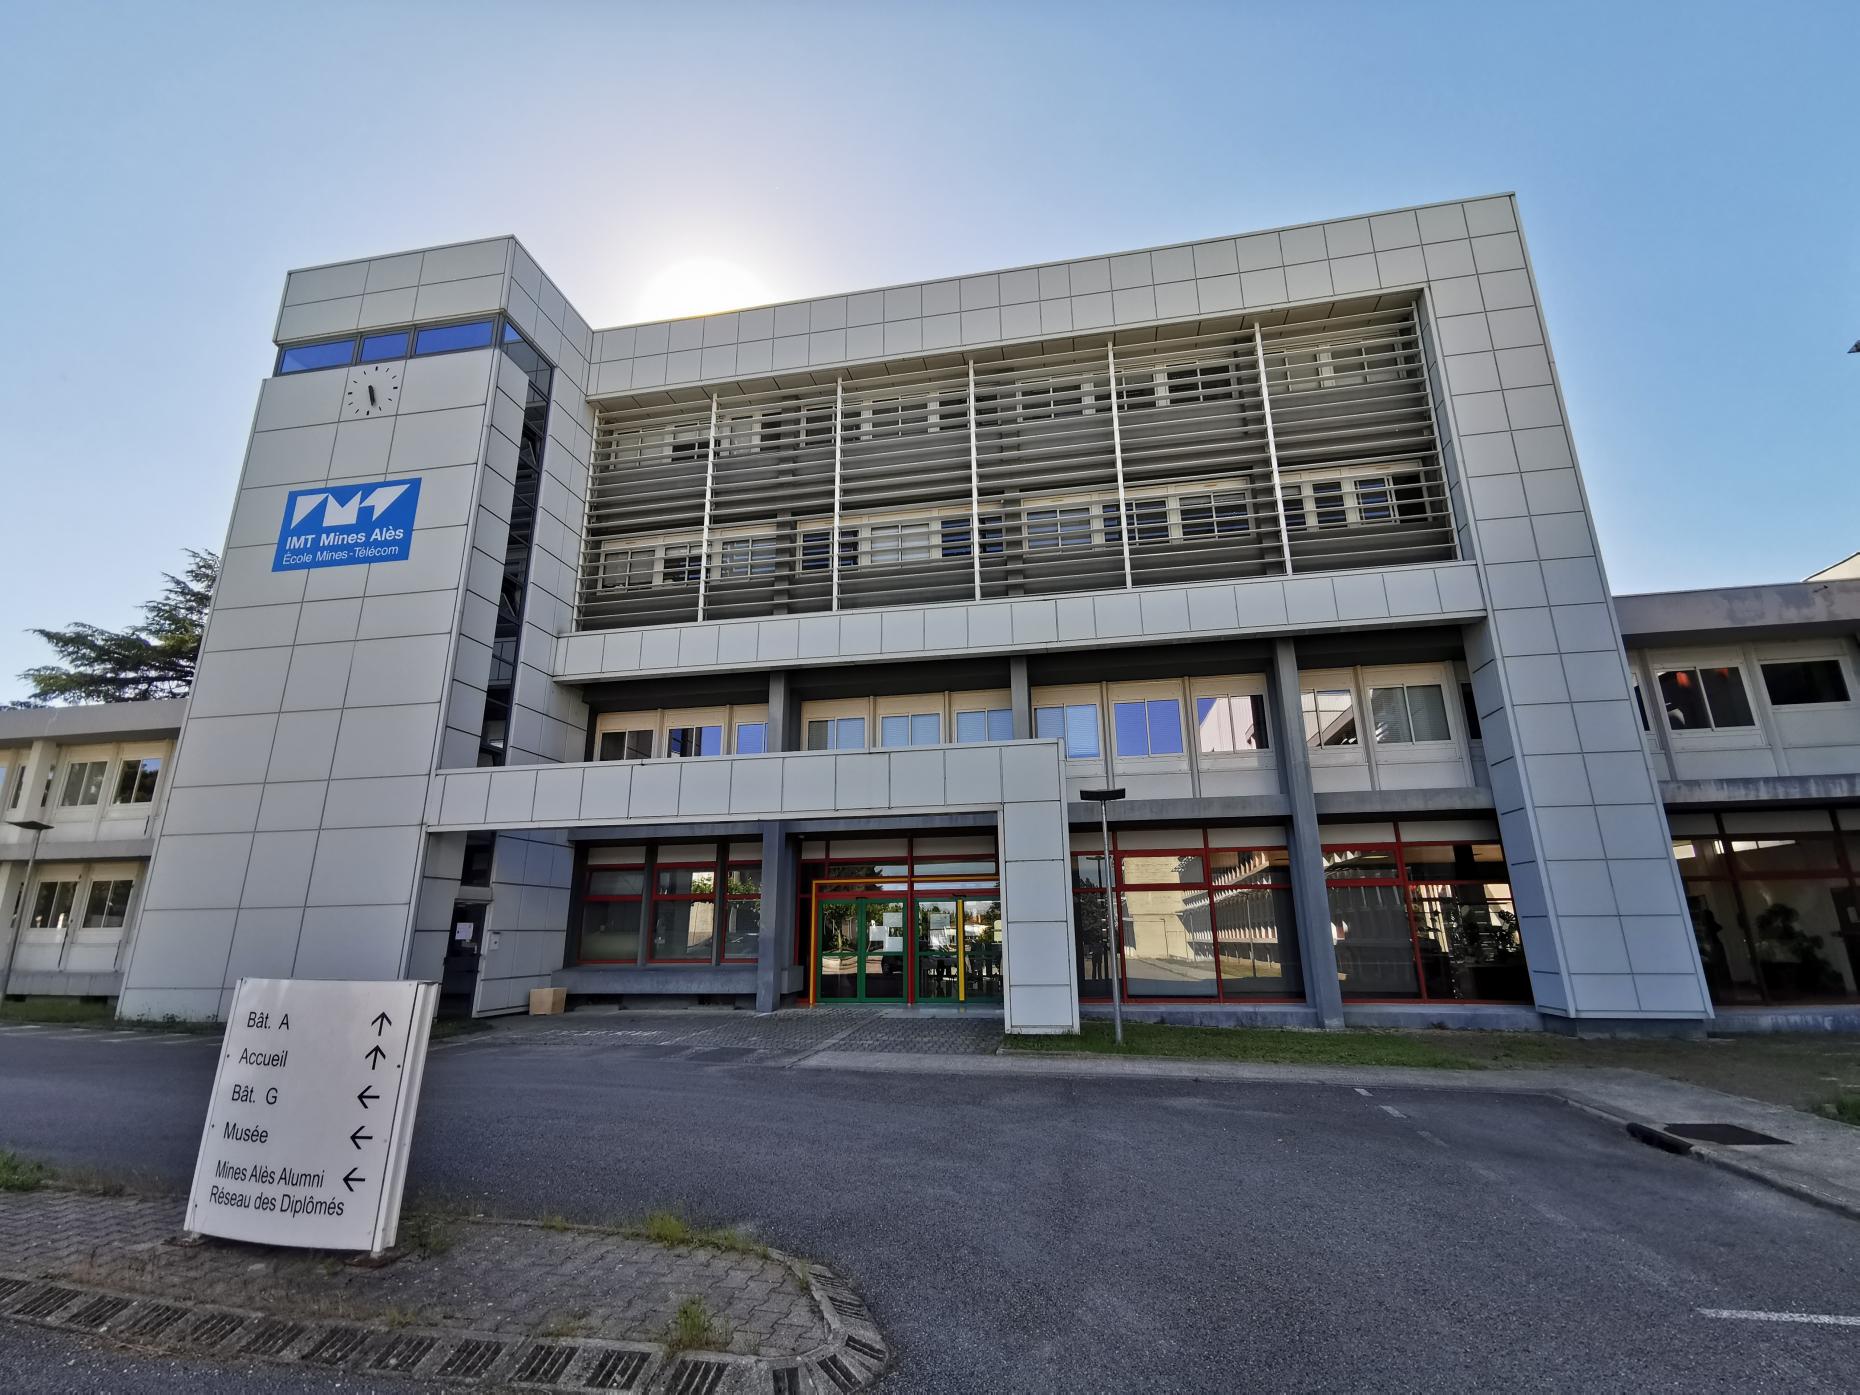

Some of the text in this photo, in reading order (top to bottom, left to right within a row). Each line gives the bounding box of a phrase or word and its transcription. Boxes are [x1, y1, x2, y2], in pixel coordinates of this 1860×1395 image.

[286, 526, 403, 549] IMT Mines Alès
[283, 552, 312, 565] École
[247, 1012, 290, 1030] Bât. A
[239, 1048, 287, 1067] Accueil
[232, 1084, 278, 1104] Bât. G
[224, 1122, 268, 1143] Musée
[215, 1160, 324, 1188] Mines Alès Alumni
[209, 1185, 344, 1218] Réseau des Diplômés
